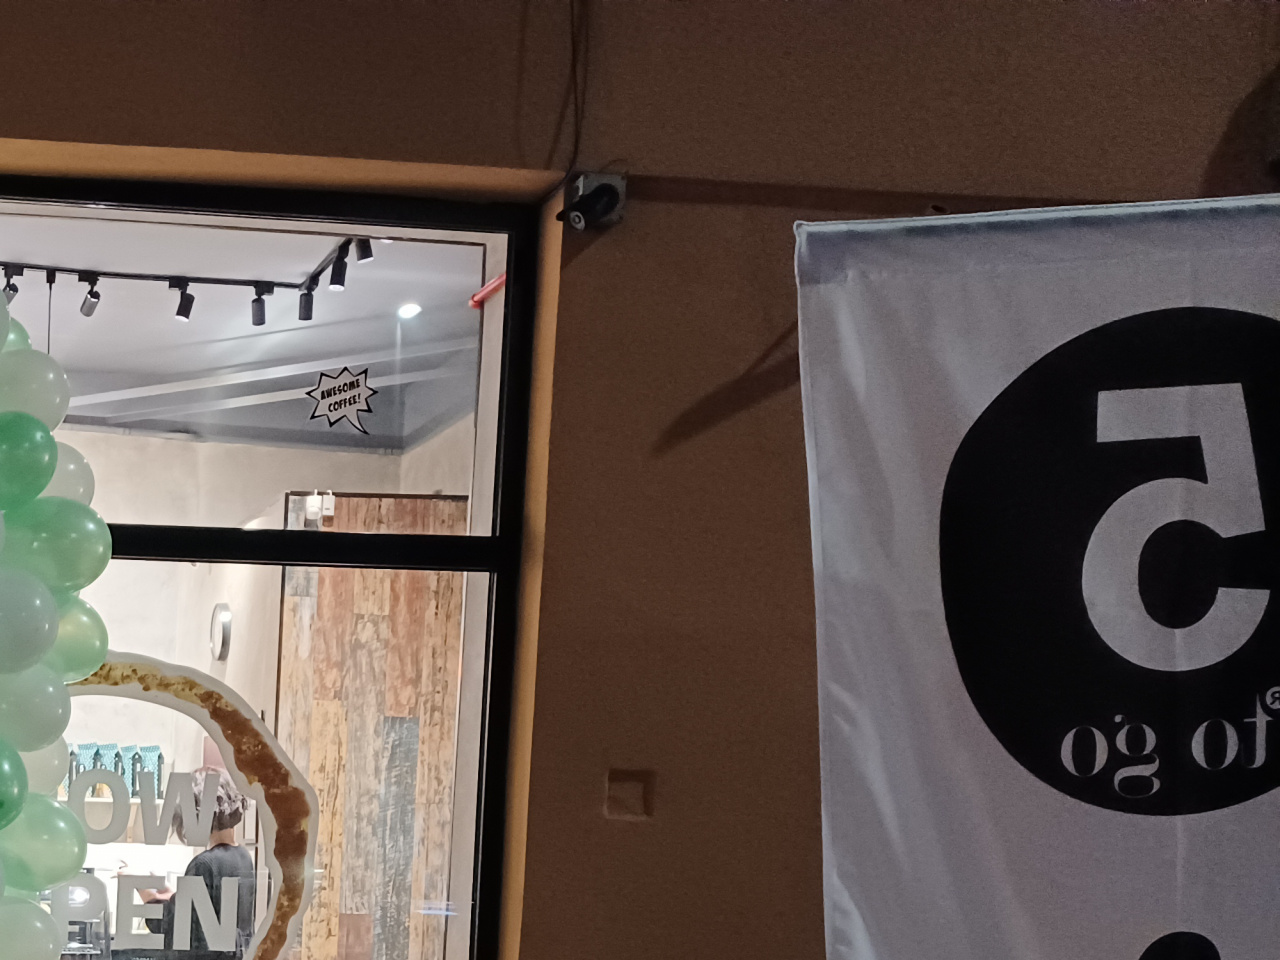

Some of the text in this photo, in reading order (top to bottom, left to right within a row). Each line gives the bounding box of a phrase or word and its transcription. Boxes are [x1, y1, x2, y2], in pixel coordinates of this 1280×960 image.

[321, 379, 361, 400] AWESOME
[328, 393, 361, 412] COFFEE!
[67, 768, 220, 847] OW
[50, 872, 239, 951] PEN
